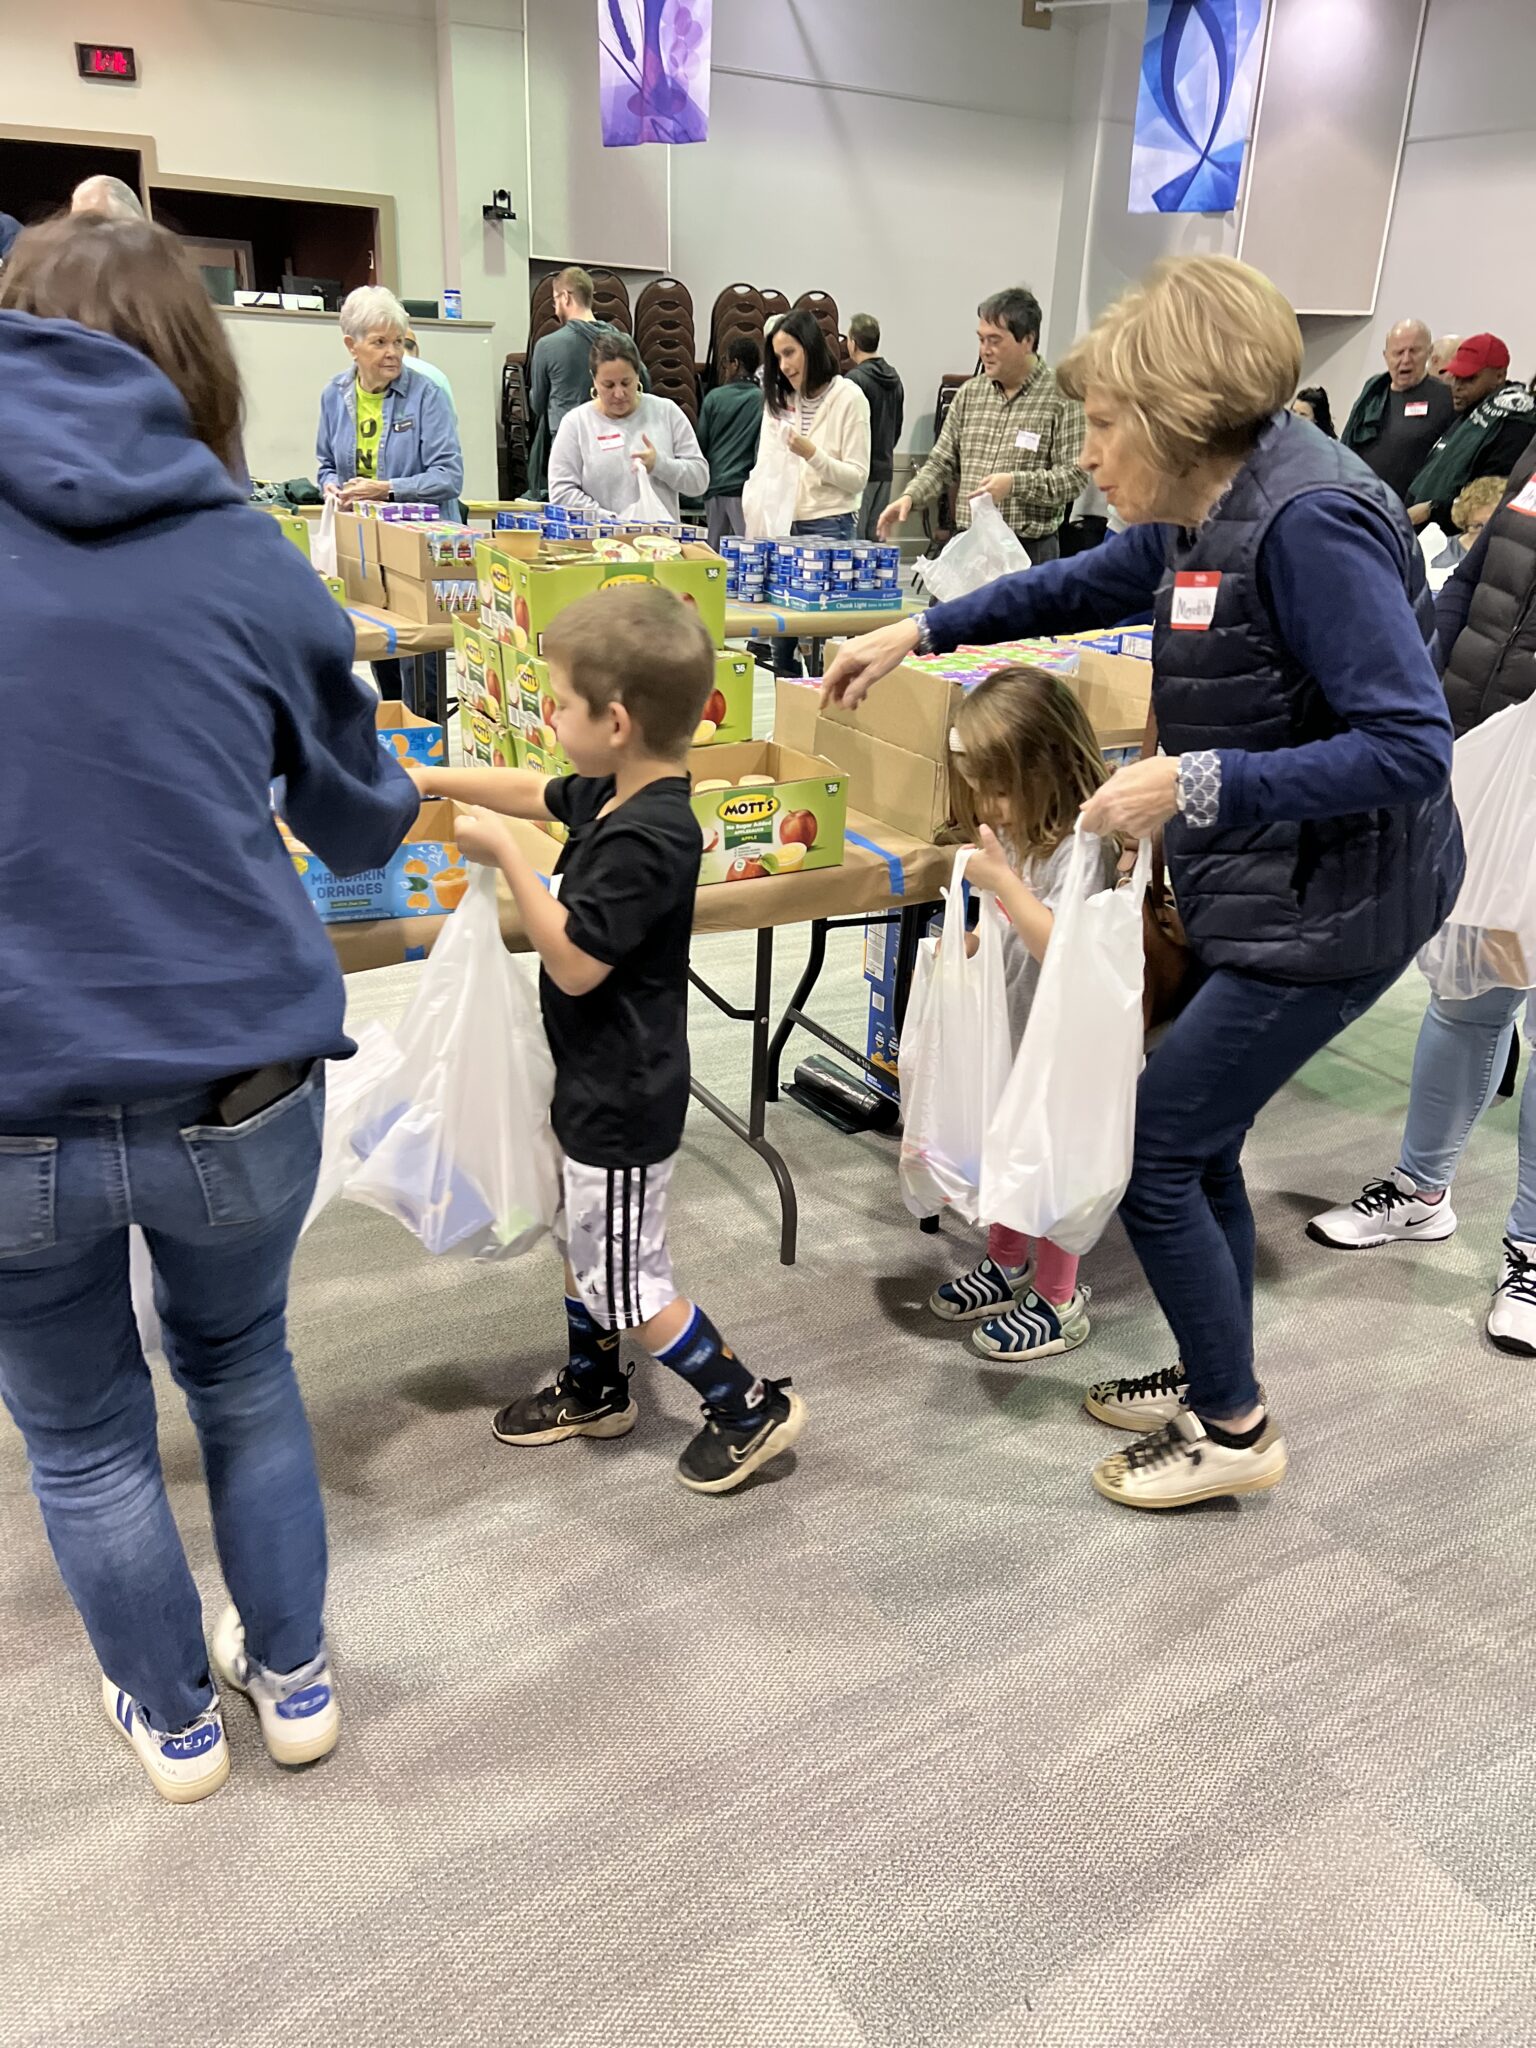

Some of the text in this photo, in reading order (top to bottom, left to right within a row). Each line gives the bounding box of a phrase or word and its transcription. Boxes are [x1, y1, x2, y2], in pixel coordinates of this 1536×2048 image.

[707, 568, 718, 577] 36
[735, 664, 745, 674] 36
[827, 783, 838, 793] 36
[724, 800, 773, 816] MOTT'S
[735, 823, 752, 831] Sugar
[317, 883, 383, 899] ORANGES
